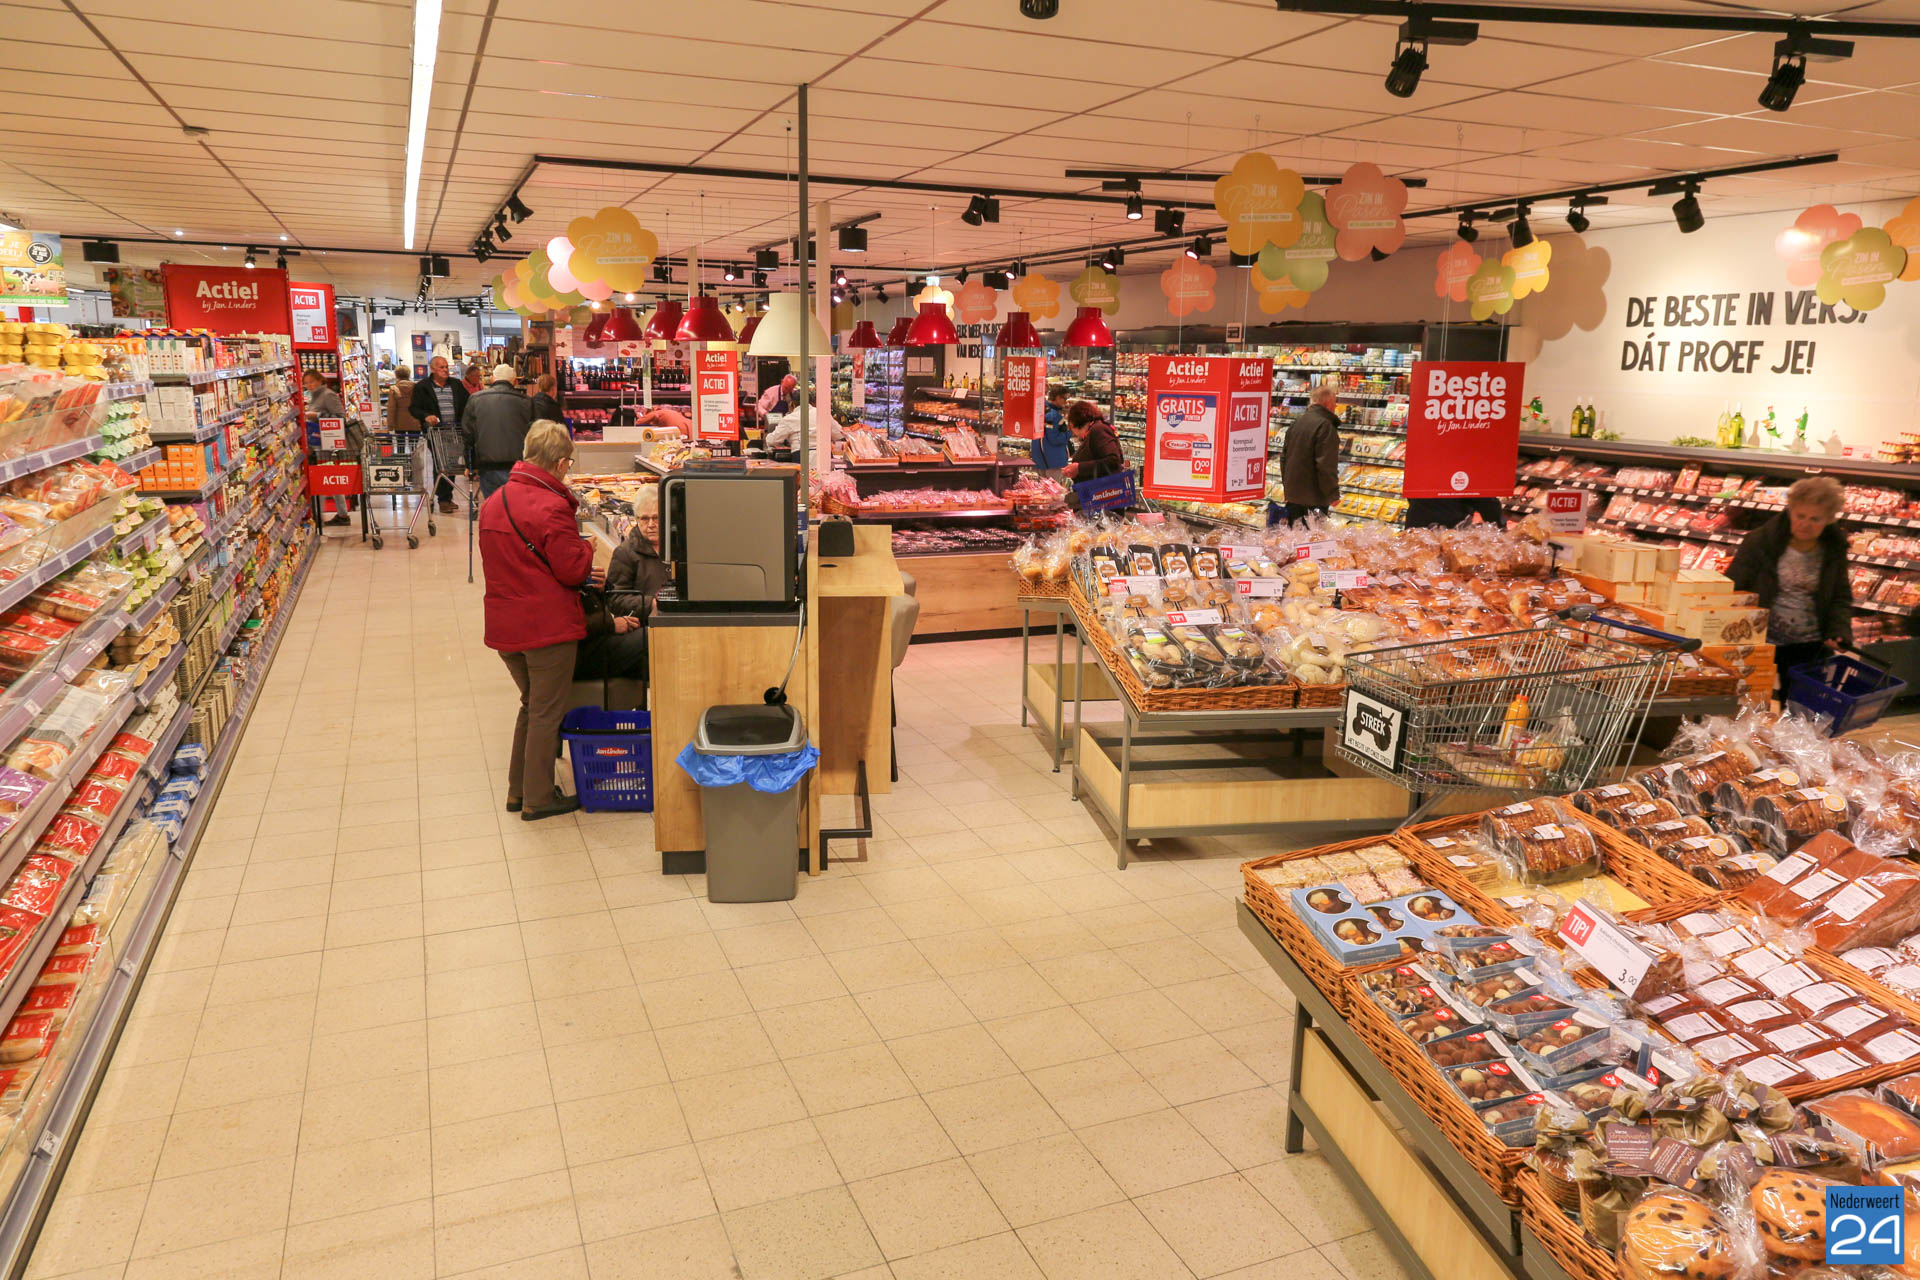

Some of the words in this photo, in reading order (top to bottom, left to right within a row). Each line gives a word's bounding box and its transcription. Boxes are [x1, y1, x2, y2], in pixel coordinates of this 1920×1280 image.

[196, 280, 259, 300] Actie!
[202, 300, 211, 313] by
[211, 300, 227, 310] Jan
[227, 299, 257, 310] Linders
[1625, 296, 1657, 328] DE
[1663, 293, 1740, 327] BESTE
[1746, 291, 1775, 326] IN
[705, 353, 728, 362] Actie!
[1620, 331, 1671, 372] DÁT
[1677, 339, 1764, 374] PROEF
[1770, 340, 1816, 375] JE!
[1008, 361, 1031, 378] Beste
[1166, 361, 1209, 376] Actie!
[1239, 362, 1264, 377] Actie!
[703, 378, 726, 389] ACTIE!
[1007, 377, 1031, 392] acties
[1169, 377, 1176, 387] by
[1176, 376, 1185, 384] Jan
[1186, 376, 1207, 384] Linders
[1427, 369, 1507, 397] Beste
[1160, 399, 1205, 415] GRATIS
[1233, 404, 1259, 422] ACTIE!
[1423, 391, 1507, 420] acties
[321, 421, 339, 429] ACTIE!
[1437, 421, 1445, 436] by
[1446, 421, 1460, 432] Jan
[1462, 419, 1491, 430] Linders
[323, 475, 349, 485] ACTIE!
[1551, 496, 1577, 508] ACTIE!
[1299, 548, 1310, 558] TIP!
[1238, 582, 1250, 593] TIP!
[1360, 711, 1386, 736] STREEK
[607, 747, 628, 755] Linders
[1568, 914, 1590, 940] TIP!
[1618, 968, 1638, 986] 3,00
